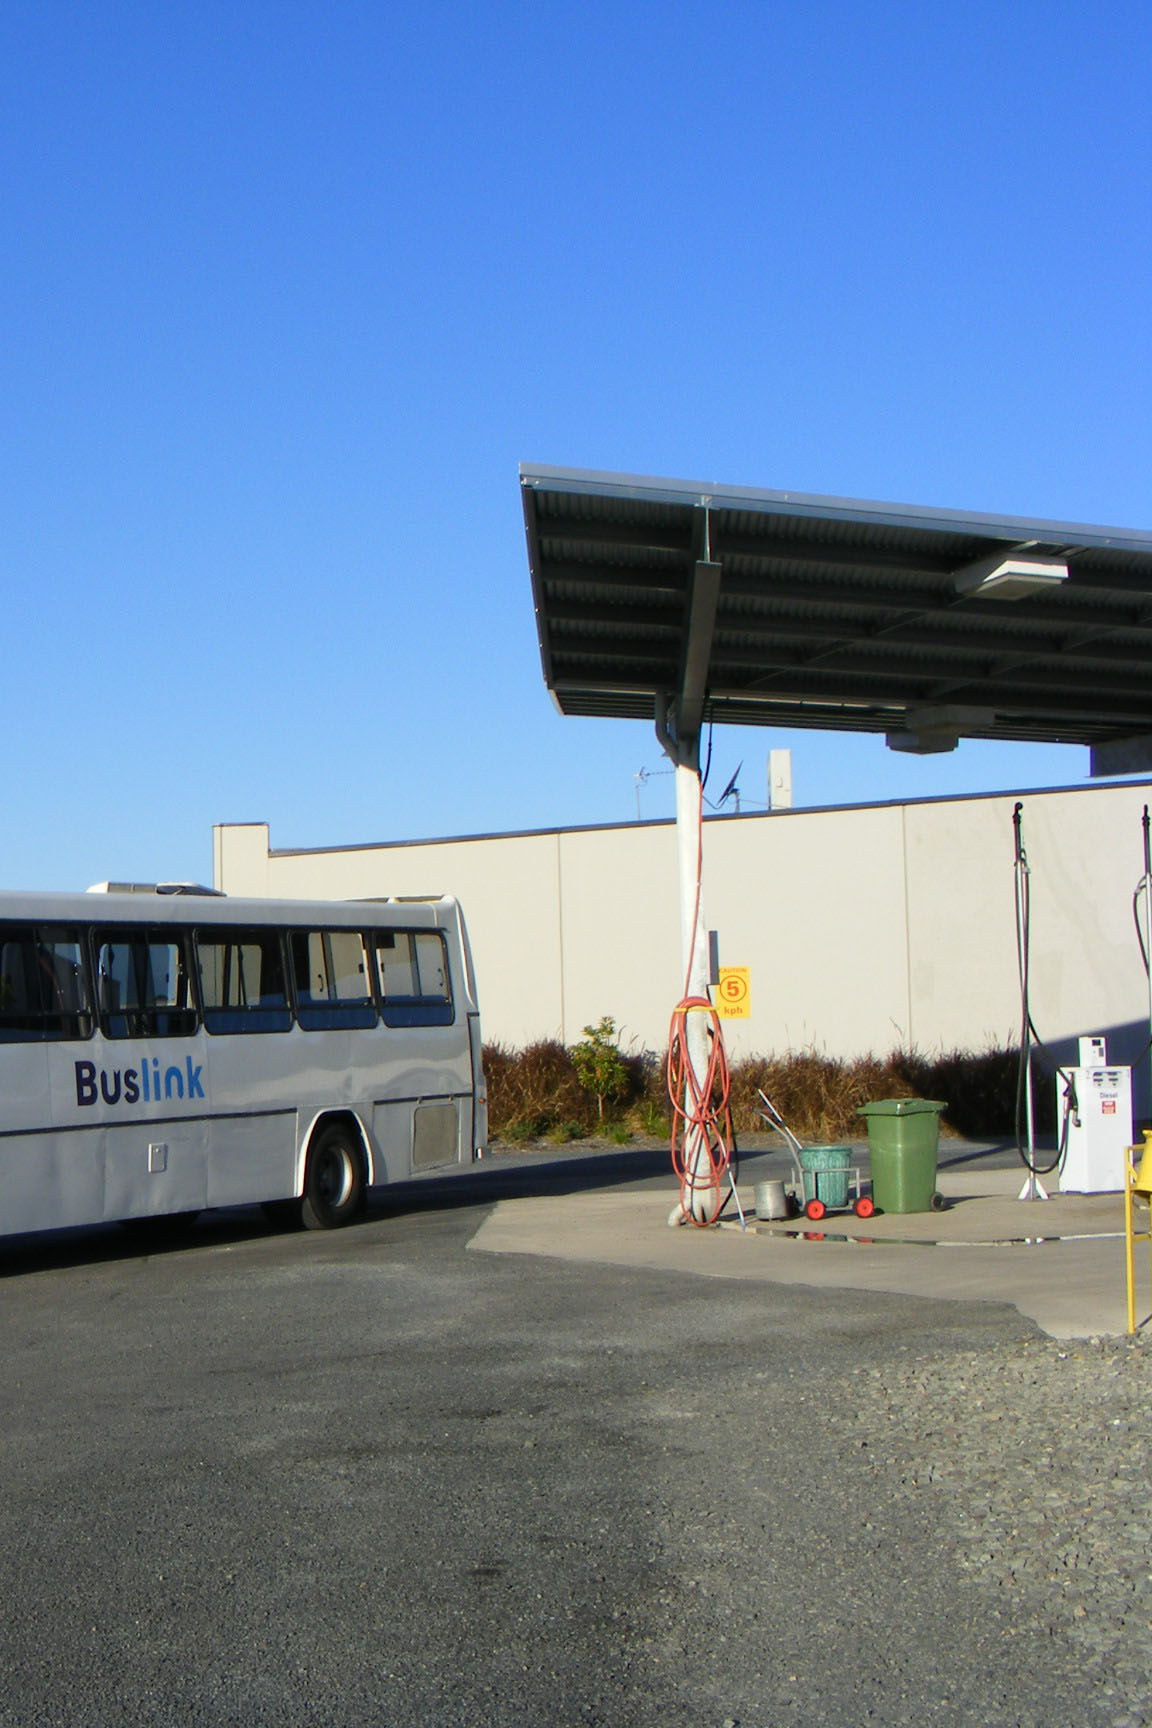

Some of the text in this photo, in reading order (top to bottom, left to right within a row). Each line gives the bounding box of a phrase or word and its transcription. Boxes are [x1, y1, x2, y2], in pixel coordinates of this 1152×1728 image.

[727, 981, 739, 997] 5
[724, 1007, 743, 1016] kph
[74, 1055, 205, 1107] Buslink
